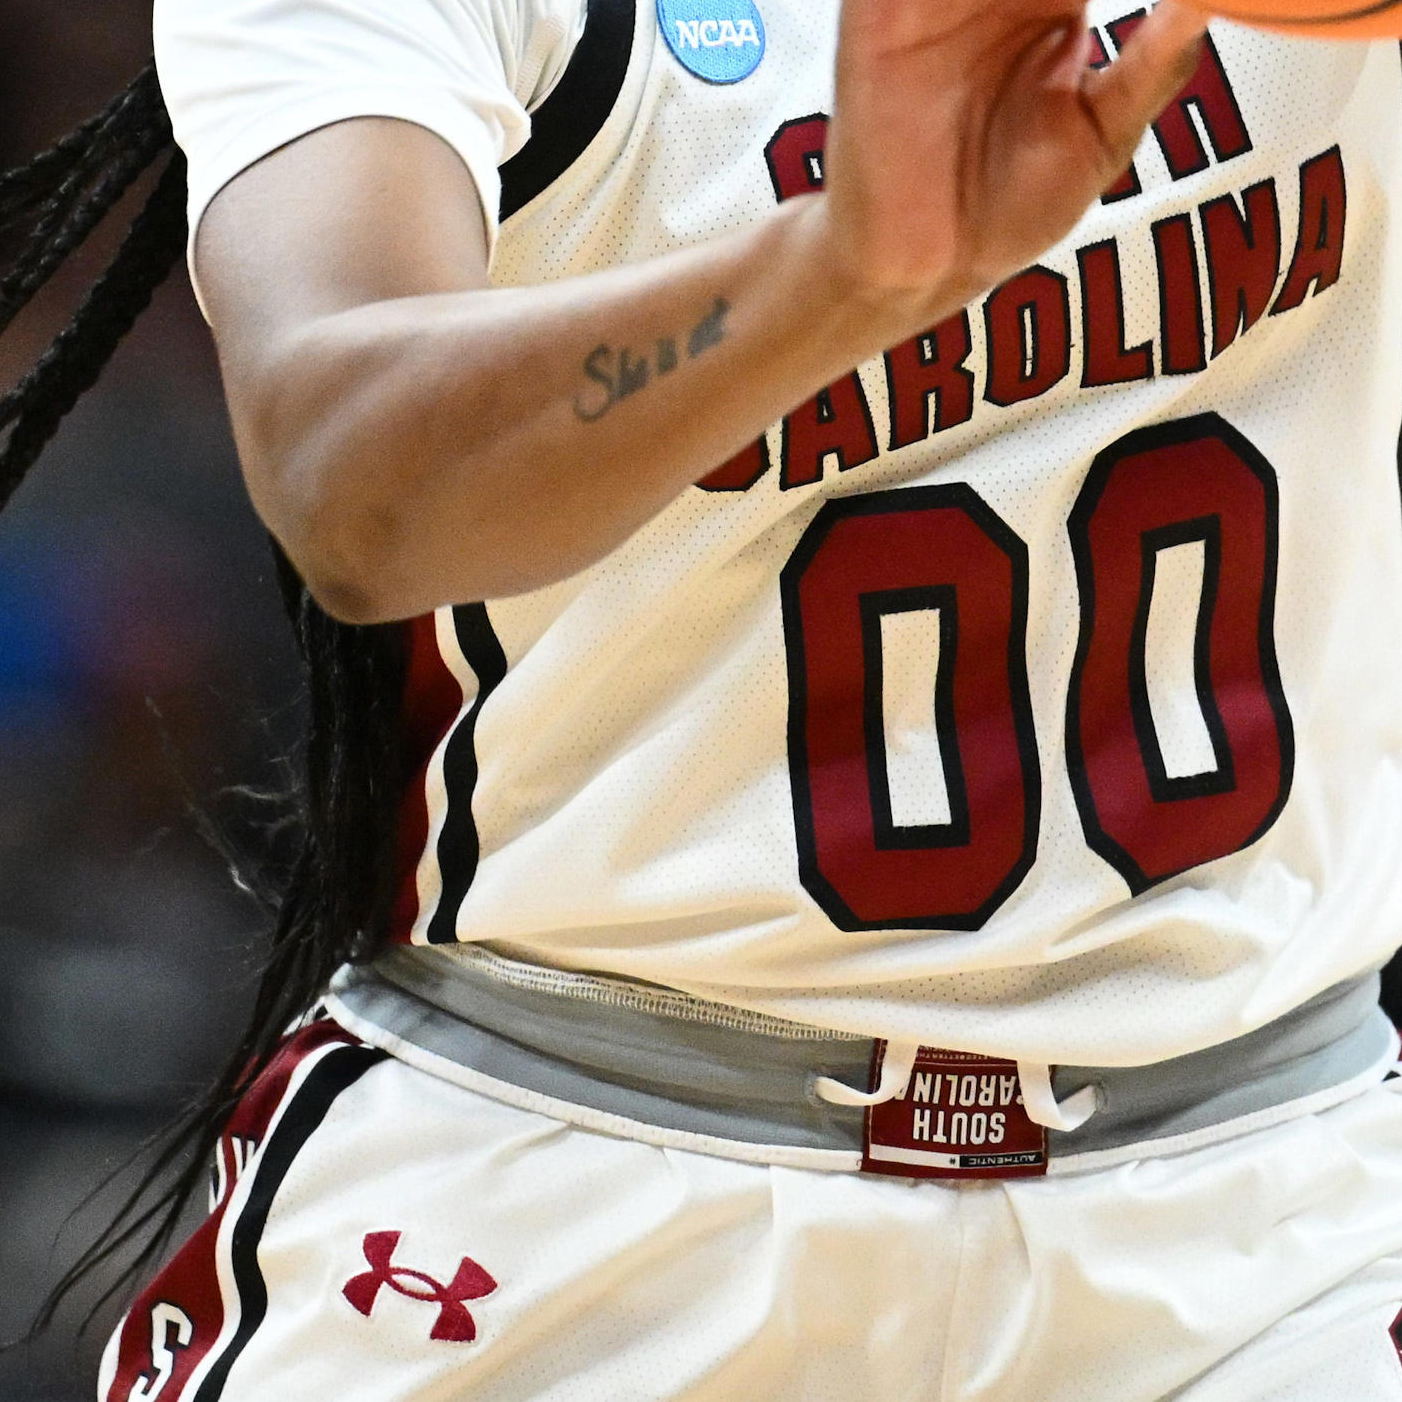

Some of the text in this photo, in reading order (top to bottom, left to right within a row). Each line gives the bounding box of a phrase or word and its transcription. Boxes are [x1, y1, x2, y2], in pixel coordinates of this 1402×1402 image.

[675, 20, 760, 49] NCAA
[780, 411, 1295, 932] 00
[895, 1072, 1025, 1107] AROLIN
[913, 1109, 1006, 1146] SOUTH
[968, 1154, 1036, 1166] AUTHENTIC
